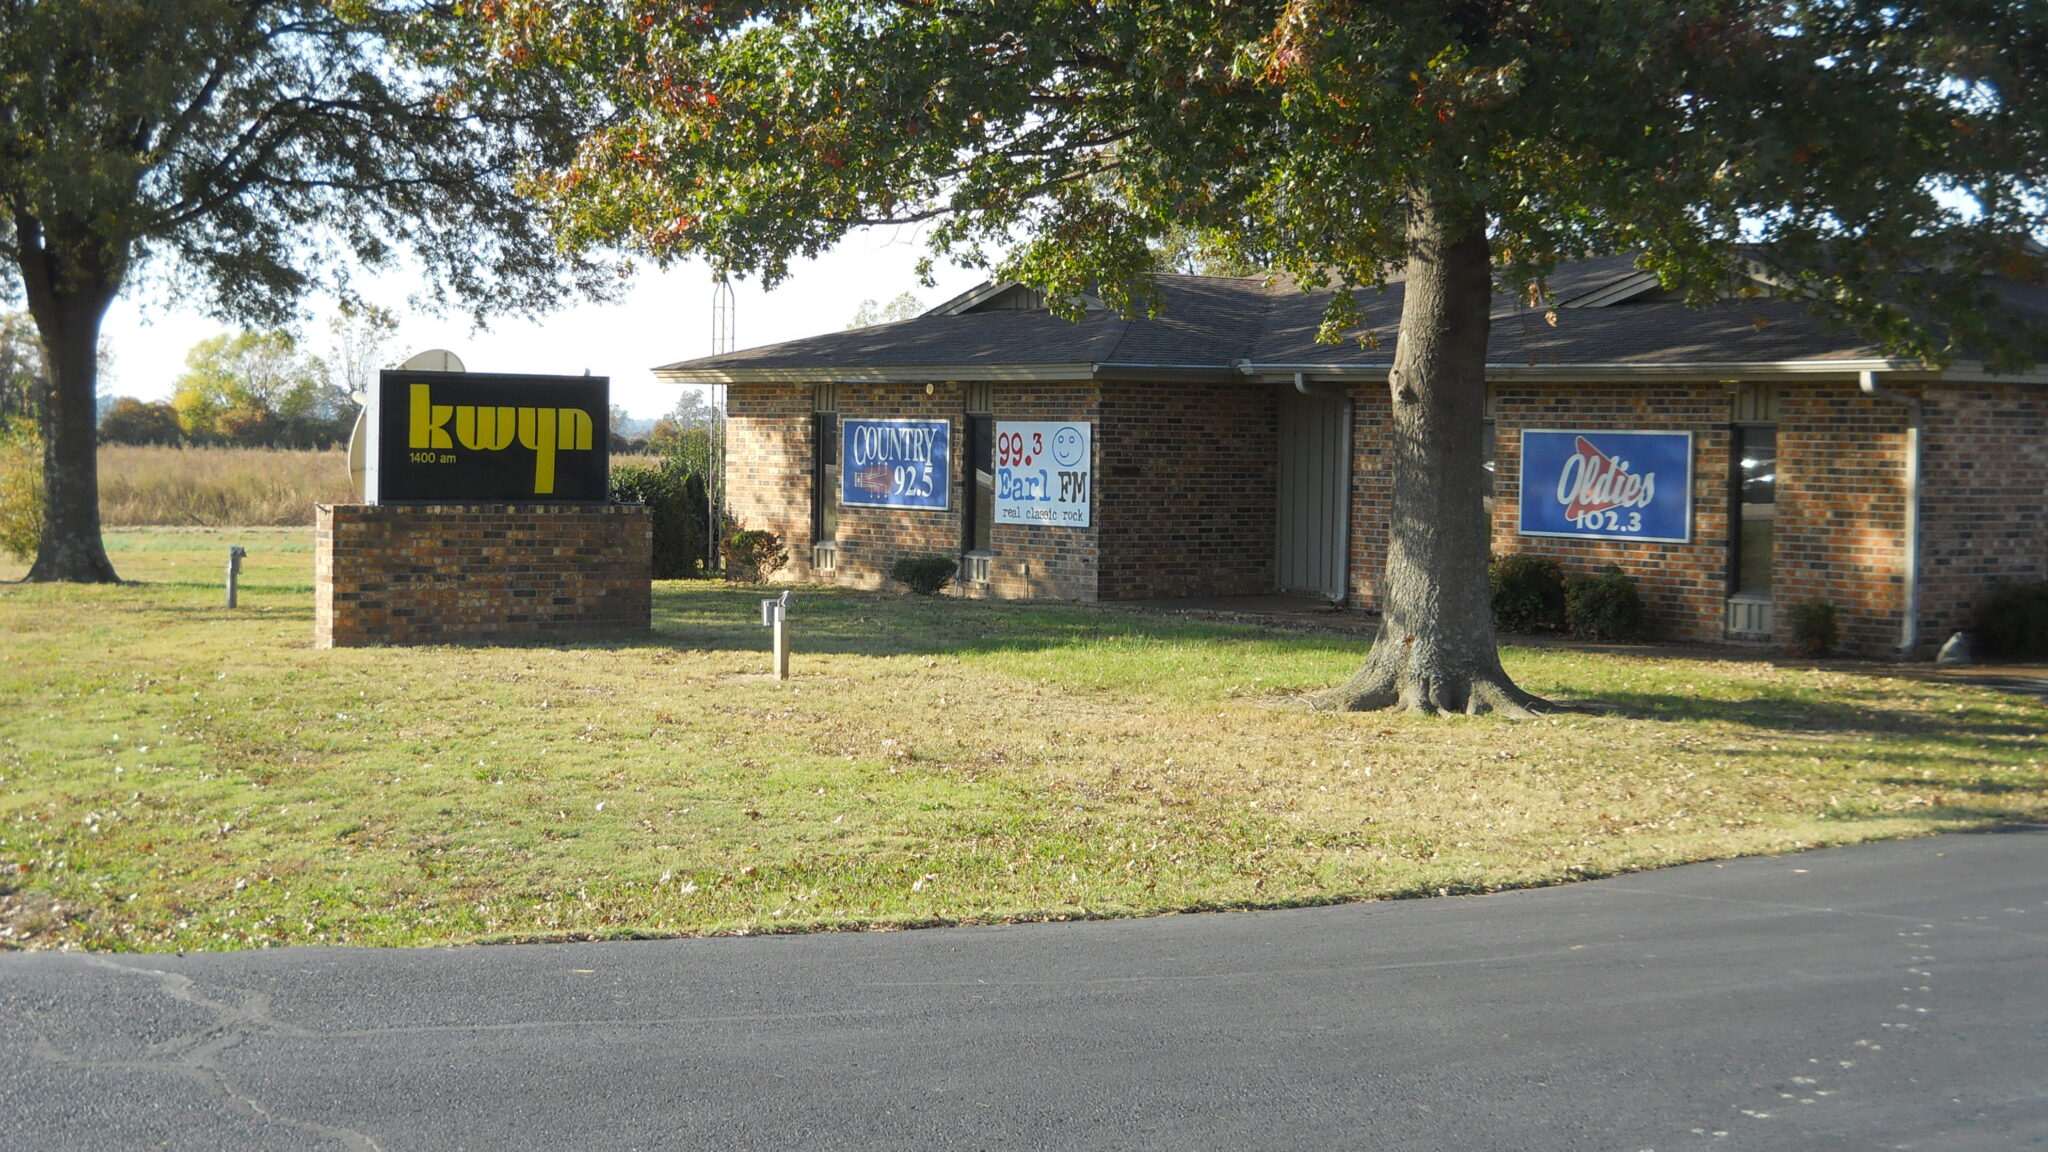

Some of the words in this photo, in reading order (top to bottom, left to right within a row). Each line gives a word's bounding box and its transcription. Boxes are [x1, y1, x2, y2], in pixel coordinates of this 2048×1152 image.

[409, 384, 593, 494] kwyn
[853, 425, 937, 466] COUNTRY
[998, 432, 1042, 467] 99.3
[409, 452, 435, 464] 1400
[440, 454, 456, 464] am
[894, 465, 933, 497] 92.5
[998, 468, 1051, 501] Earl
[1058, 471, 1087, 503] FM
[1557, 453, 1655, 508] Oldies
[1002, 506, 1021, 519] real
[1026, 507, 1057, 520] classic
[1062, 509, 1083, 522] rock
[1576, 510, 1642, 532] 102.3
